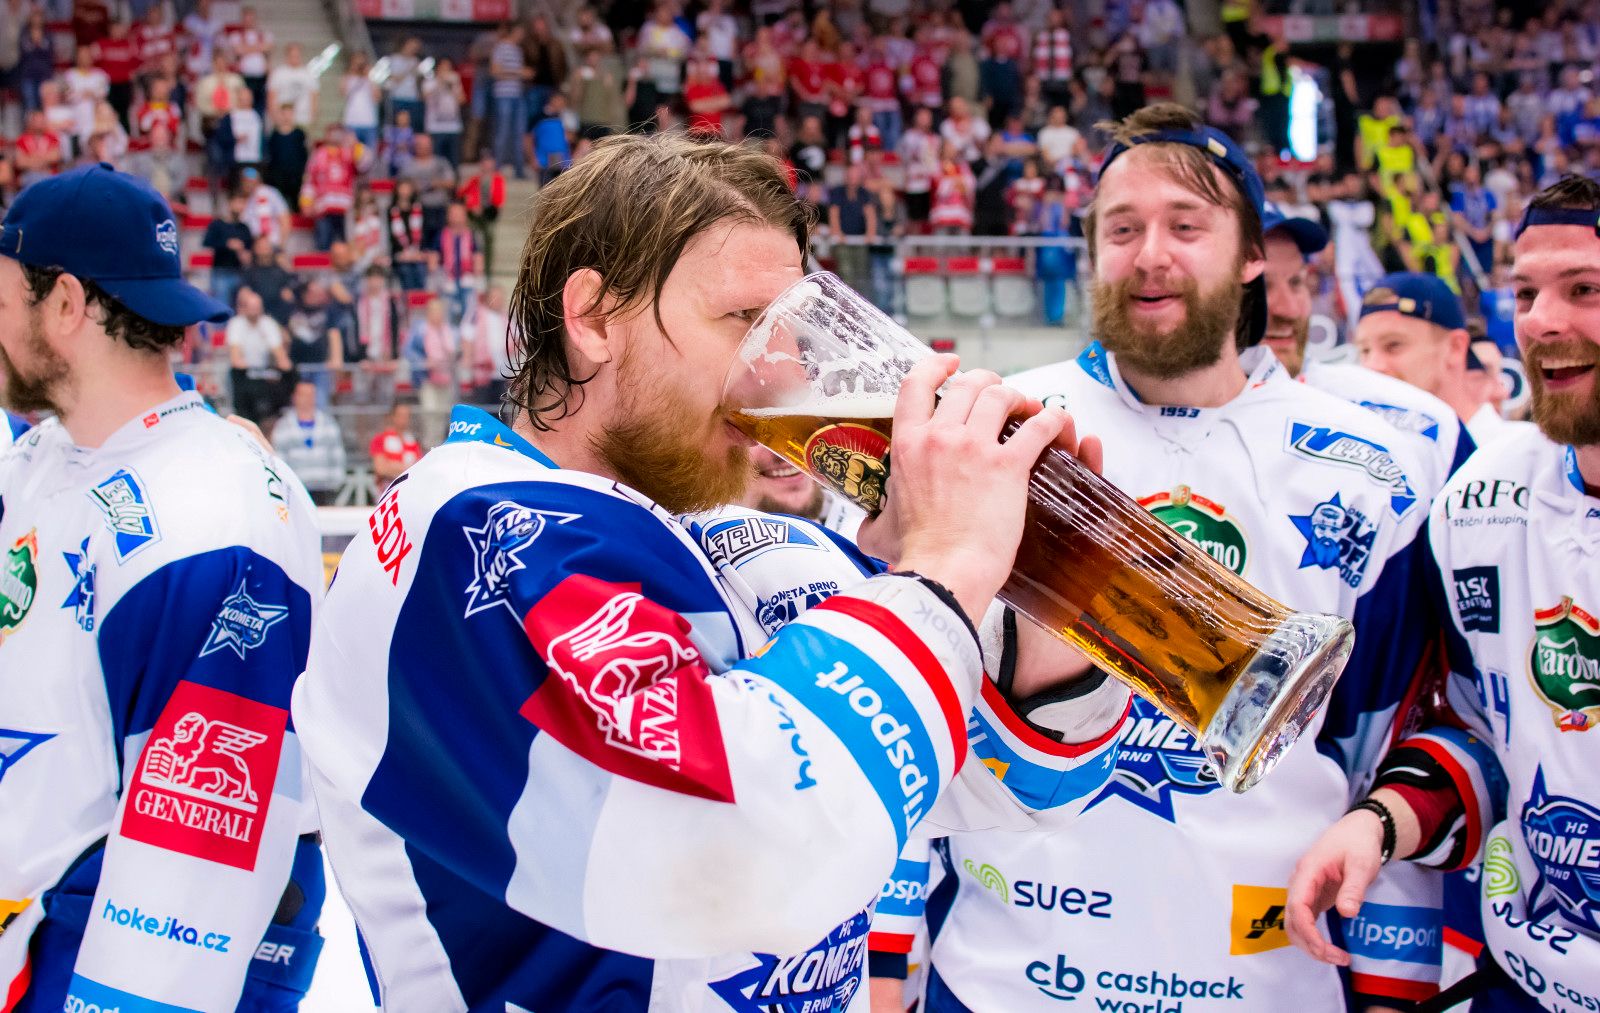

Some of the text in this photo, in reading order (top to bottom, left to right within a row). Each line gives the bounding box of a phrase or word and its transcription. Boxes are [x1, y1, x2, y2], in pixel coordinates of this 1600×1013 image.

[1159, 407, 1201, 418] 1953
[449, 421, 482, 437] port
[808, 581, 838, 593] BRNO
[218, 605, 265, 632] KOMETA
[1118, 750, 1153, 763] RNO
[134, 788, 255, 843] GENERALI
[1564, 820, 1589, 835] HC
[1525, 824, 1600, 869] KOME
[1013, 879, 1113, 919] suez
[102, 898, 232, 953] hokejka.cz
[1348, 916, 1437, 950] Tipsport
[761, 932, 866, 996] KOMETA
[1025, 954, 1086, 994] cb
[1096, 970, 1246, 1000] cashback
[1553, 981, 1600, 1012] cas
